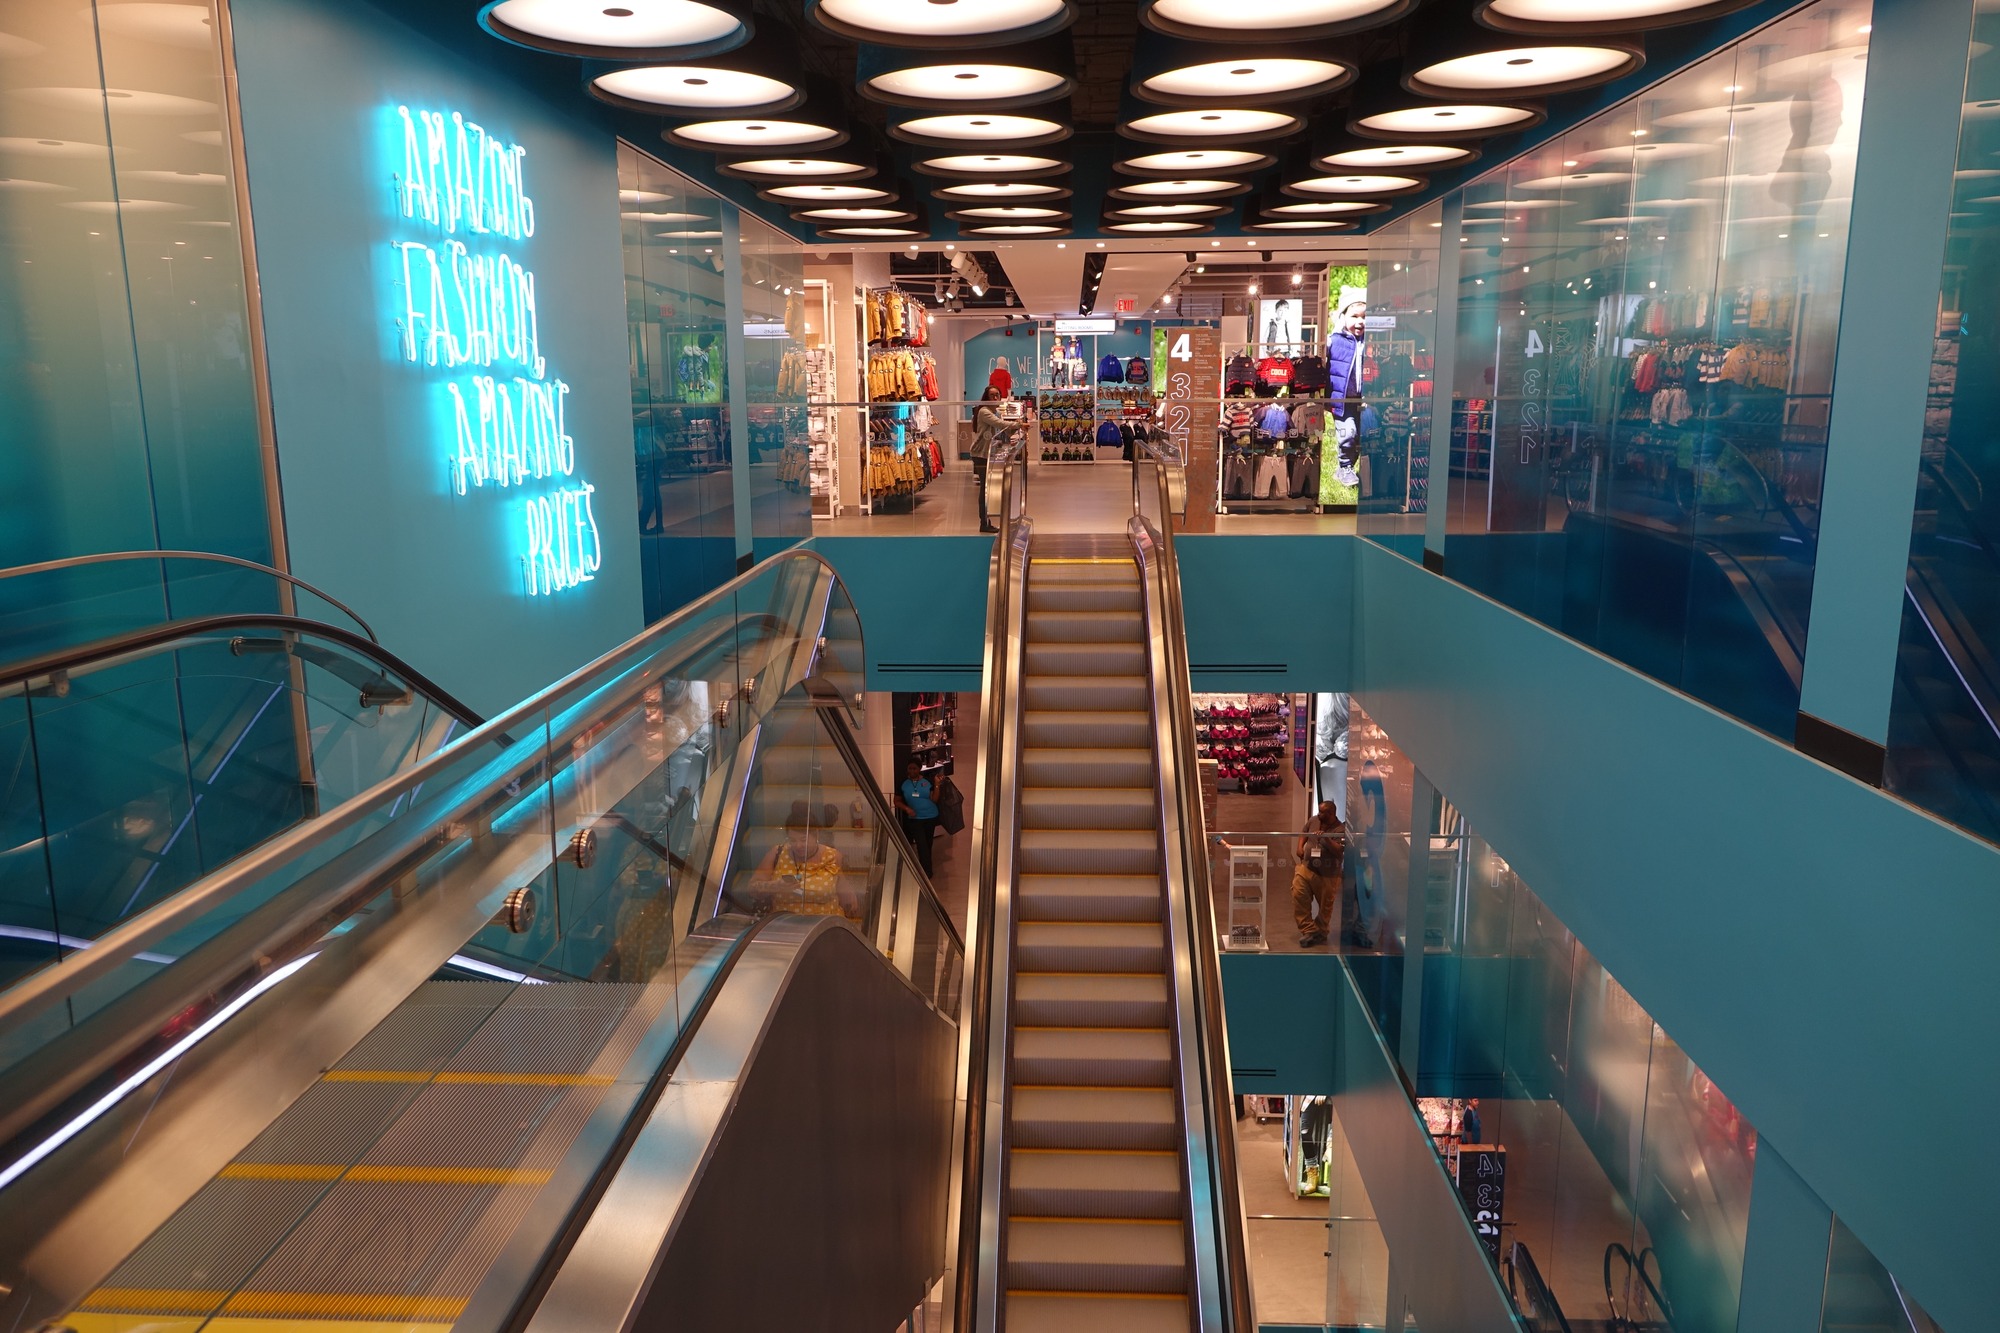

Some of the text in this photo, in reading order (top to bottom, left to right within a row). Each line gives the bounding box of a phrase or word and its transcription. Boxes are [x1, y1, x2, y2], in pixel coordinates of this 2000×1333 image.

[397, 105, 535, 241] AMAZING
[1118, 299, 1135, 311] EXIT
[1170, 333, 1193, 362] 4
[1016, 355, 1033, 375] WE
[1170, 372, 1191, 400] 3
[1169, 405, 1191, 434] 2
[448, 376, 574, 496] AMAZING
[524, 484, 601, 596] PRICES
